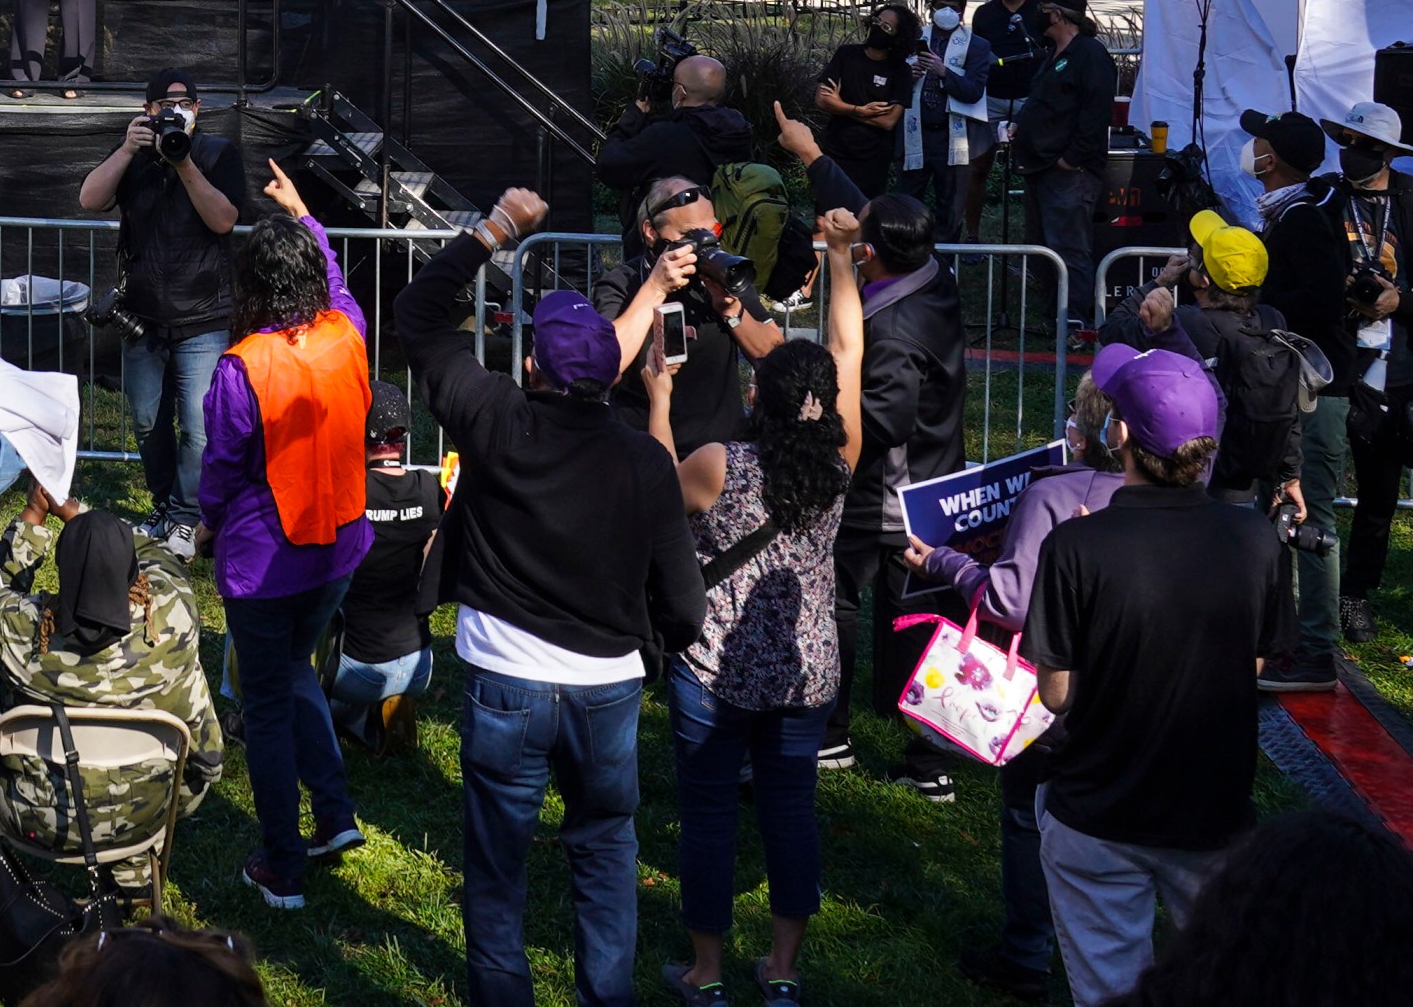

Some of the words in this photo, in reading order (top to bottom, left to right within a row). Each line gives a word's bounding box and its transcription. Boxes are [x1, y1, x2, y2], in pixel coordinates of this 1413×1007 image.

[939, 482, 1000, 516] WHEN
[365, 509, 398, 521] RUMP
[400, 506, 423, 521] LIES
